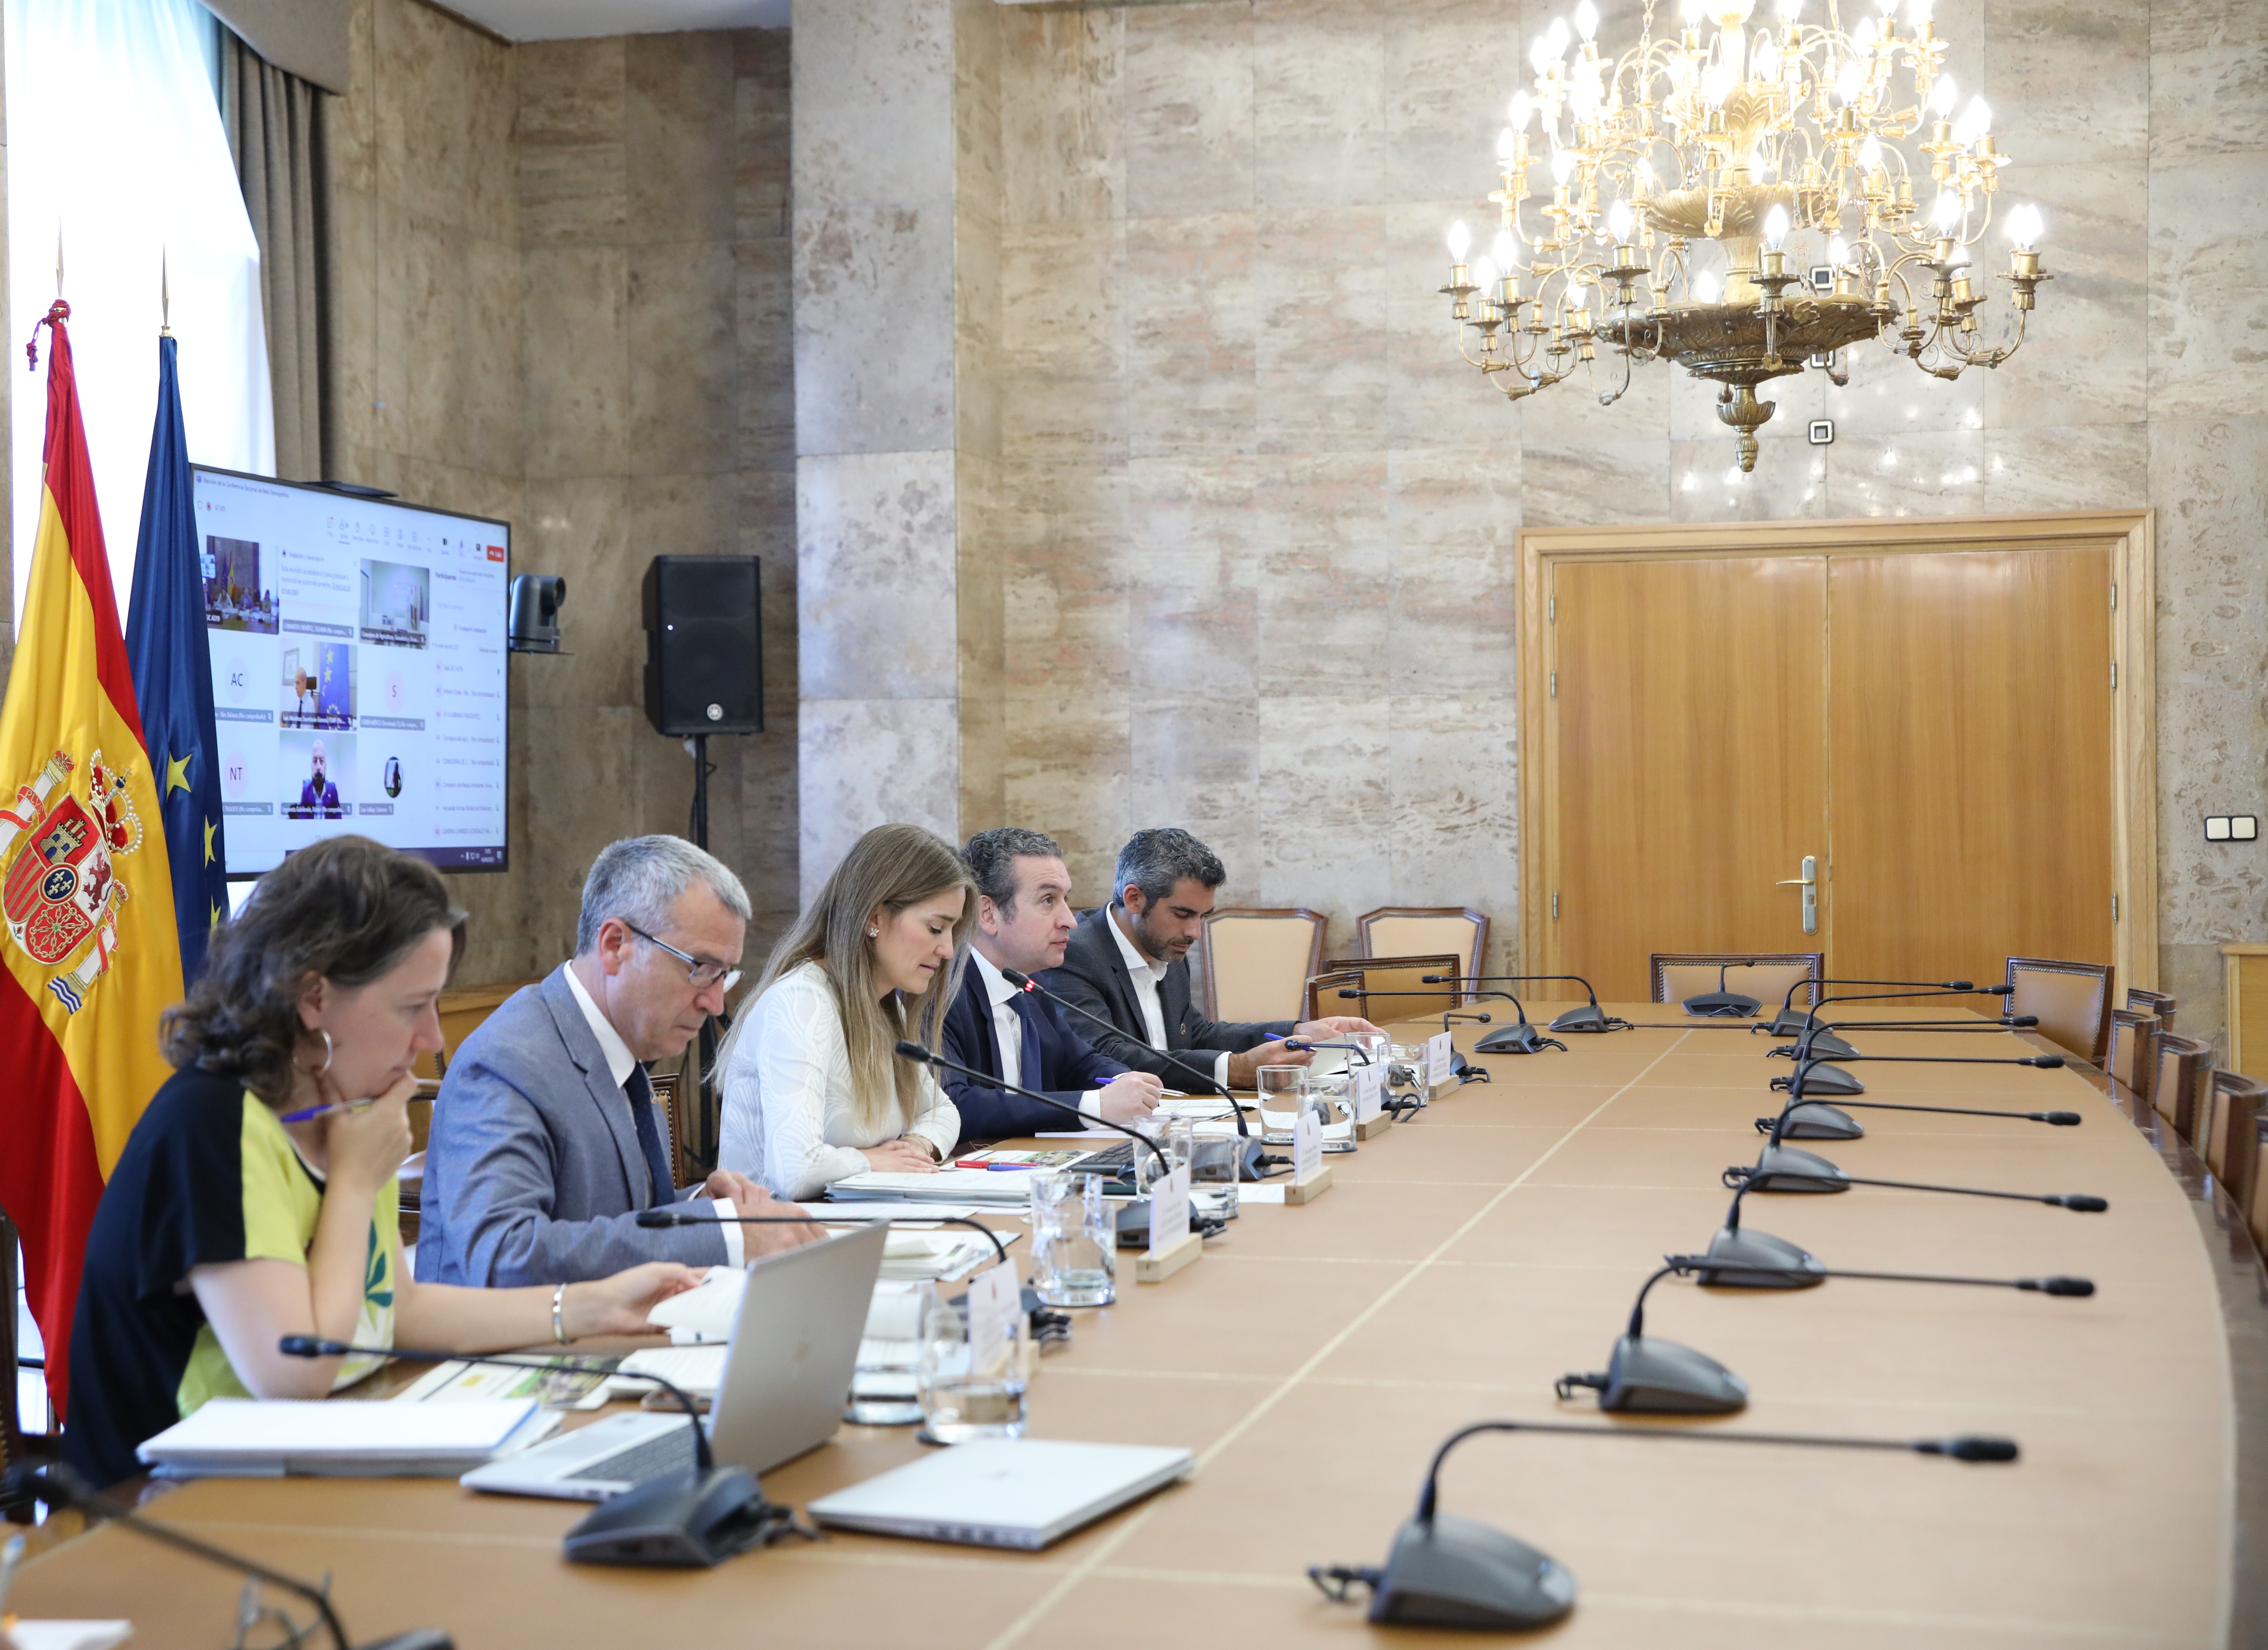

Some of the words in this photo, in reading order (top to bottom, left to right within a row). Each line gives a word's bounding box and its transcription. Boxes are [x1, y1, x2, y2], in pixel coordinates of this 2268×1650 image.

[231, 673, 243, 686] AC
[392, 685, 396, 697] S
[230, 767, 242, 780] NT
[25, 789, 43, 815] PLVS
